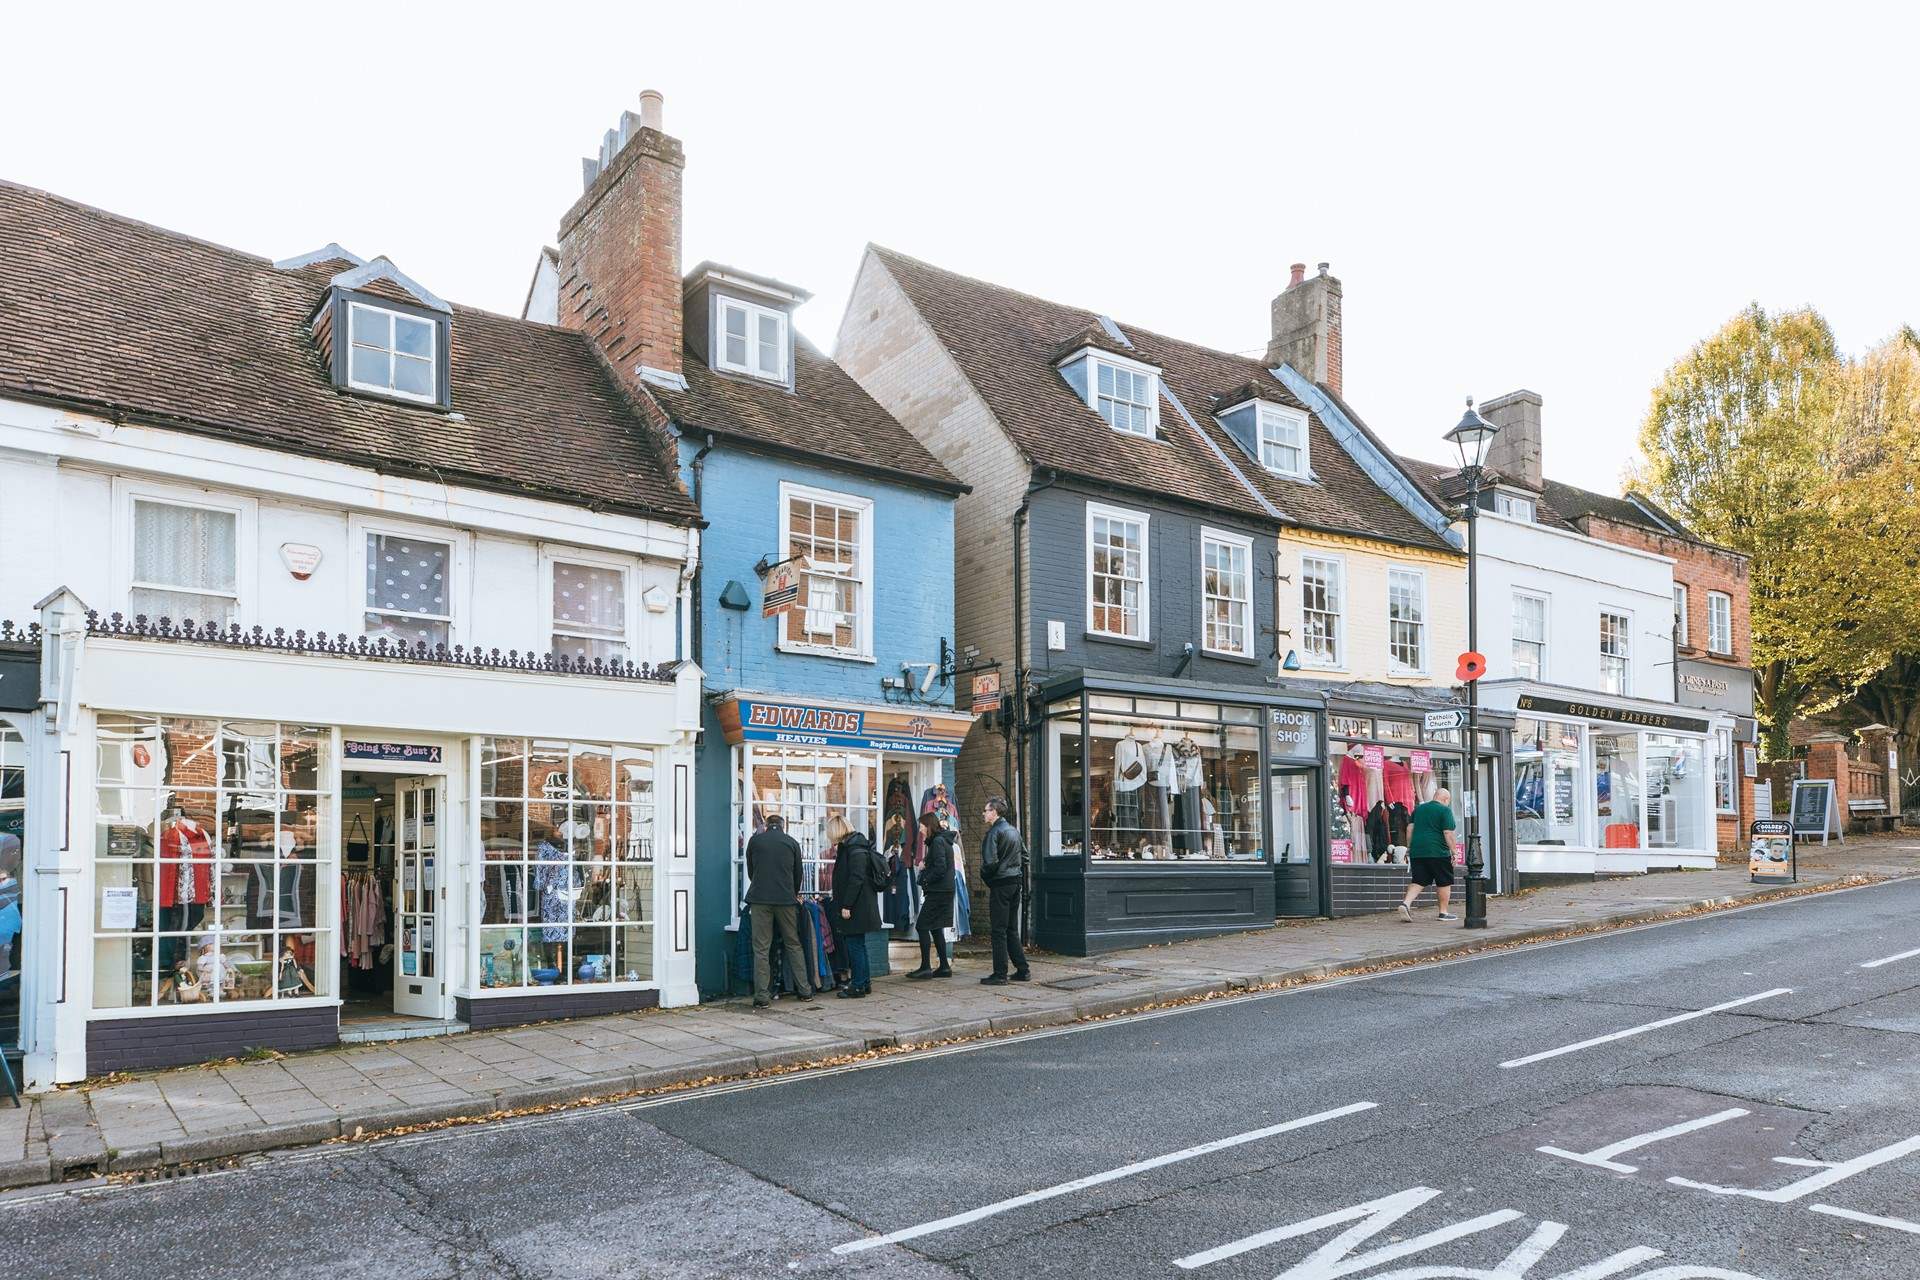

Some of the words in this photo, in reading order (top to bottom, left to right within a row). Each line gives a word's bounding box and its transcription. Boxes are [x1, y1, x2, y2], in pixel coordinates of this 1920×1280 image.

[749, 703, 859, 733] EDWARDS
[1273, 712, 1311, 726] FROCK
[1427, 713, 1454, 721] Catholic
[1569, 704, 1613, 719] GOLDEN
[1621, 712, 1668, 726] BARBERS
[1331, 718, 1368, 738] MADE
[1391, 723, 1403, 738] IN
[776, 733, 828, 745] HEAVIES
[1277, 730, 1308, 744] SHOP
[892, 742, 910, 750] Shirts
[918, 745, 954, 754] Casualwear
